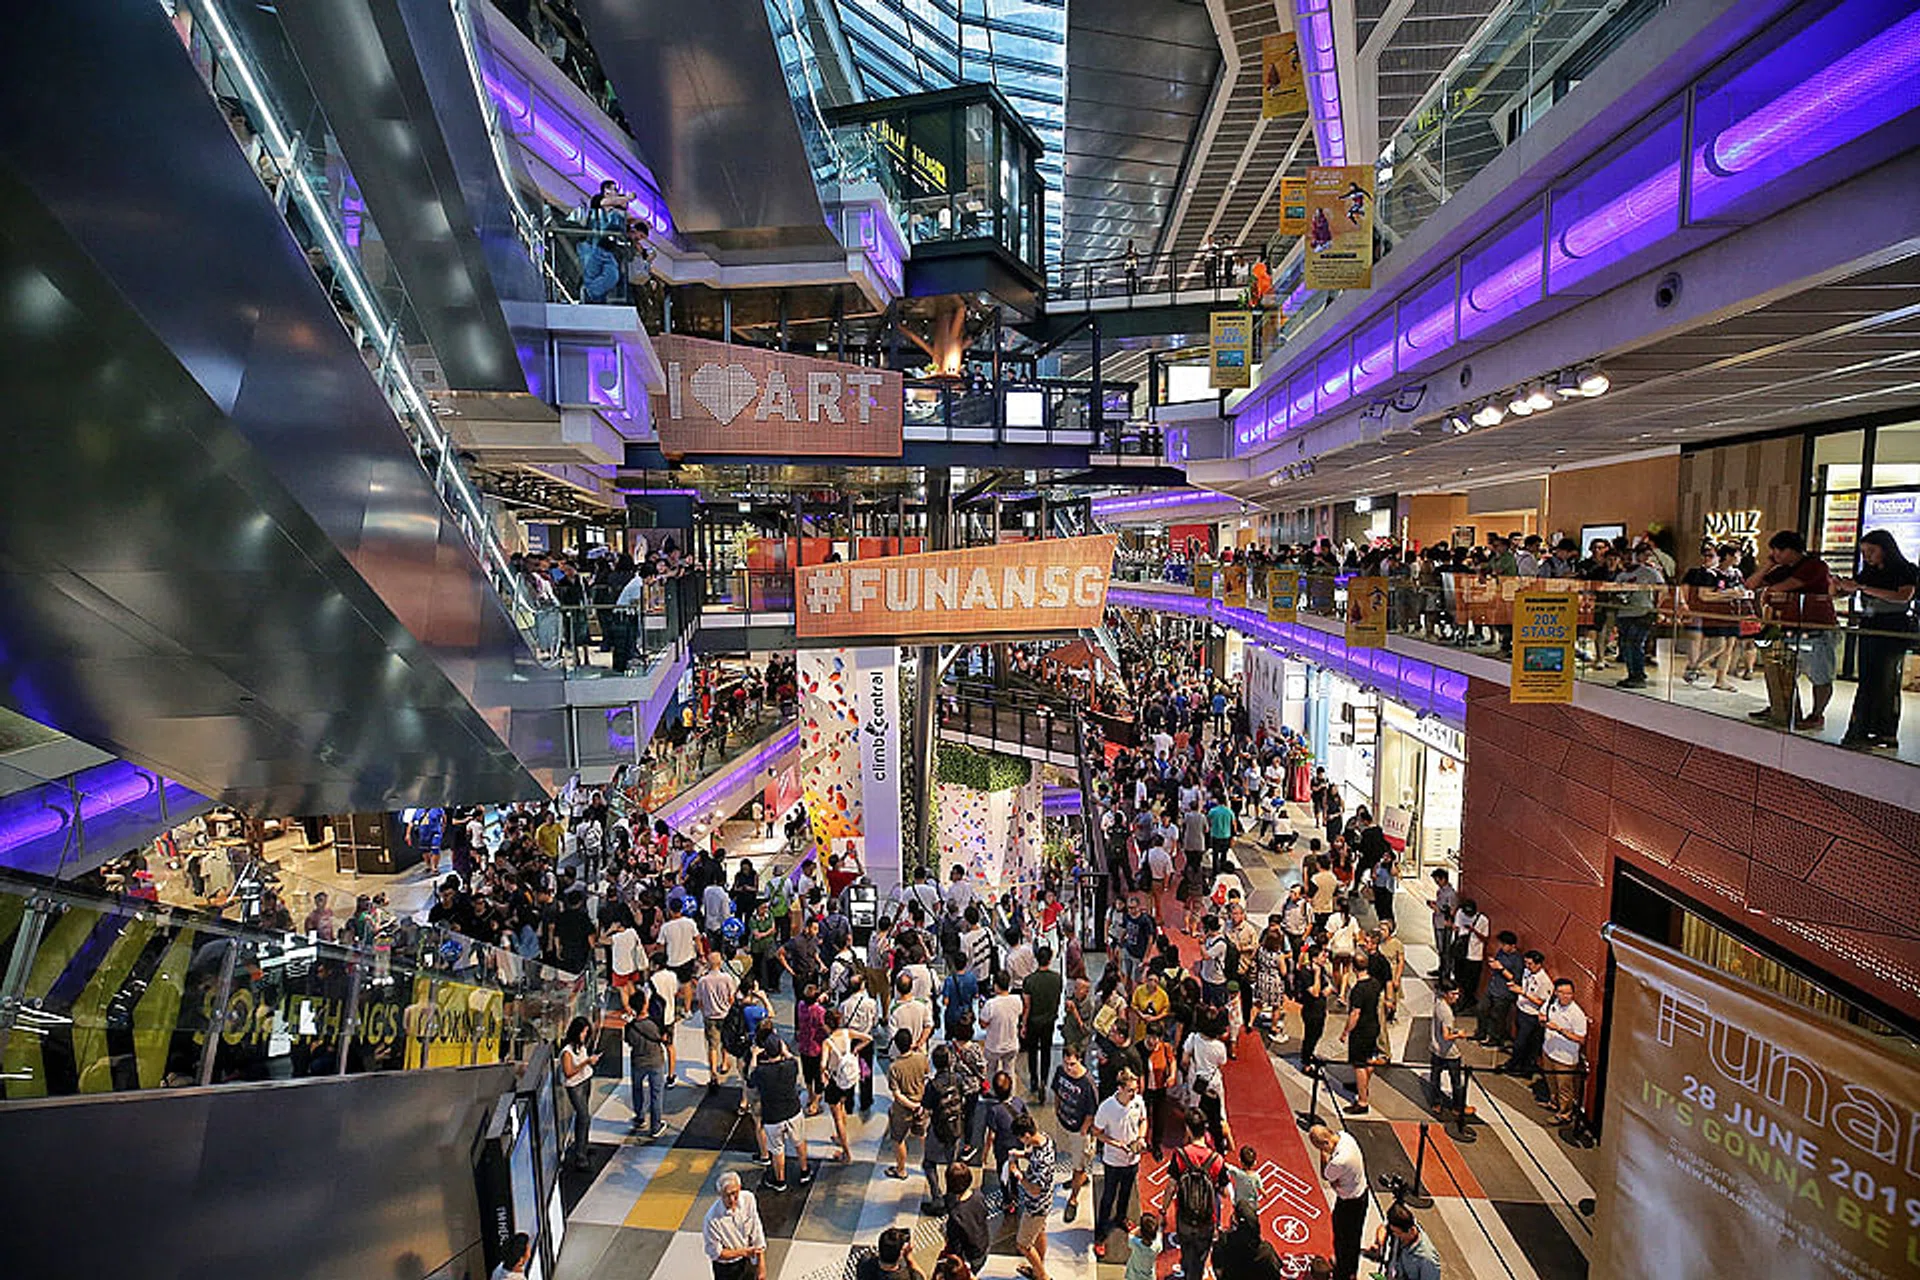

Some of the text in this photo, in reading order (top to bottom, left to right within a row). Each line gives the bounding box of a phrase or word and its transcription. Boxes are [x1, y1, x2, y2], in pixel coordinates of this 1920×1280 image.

[668, 362, 884, 424] I ART
[805, 566, 1105, 613] #FUNANSG
[1534, 613, 1559, 625] 20X
[193, 988, 399, 1046] SOMETHNG'S
[1640, 1079, 1693, 1127] IT'S
[1702, 1121, 1825, 1209] GONNA
[1837, 1195, 1892, 1249] BE
[1682, 1074, 1920, 1229] 28 JUNE 2019
